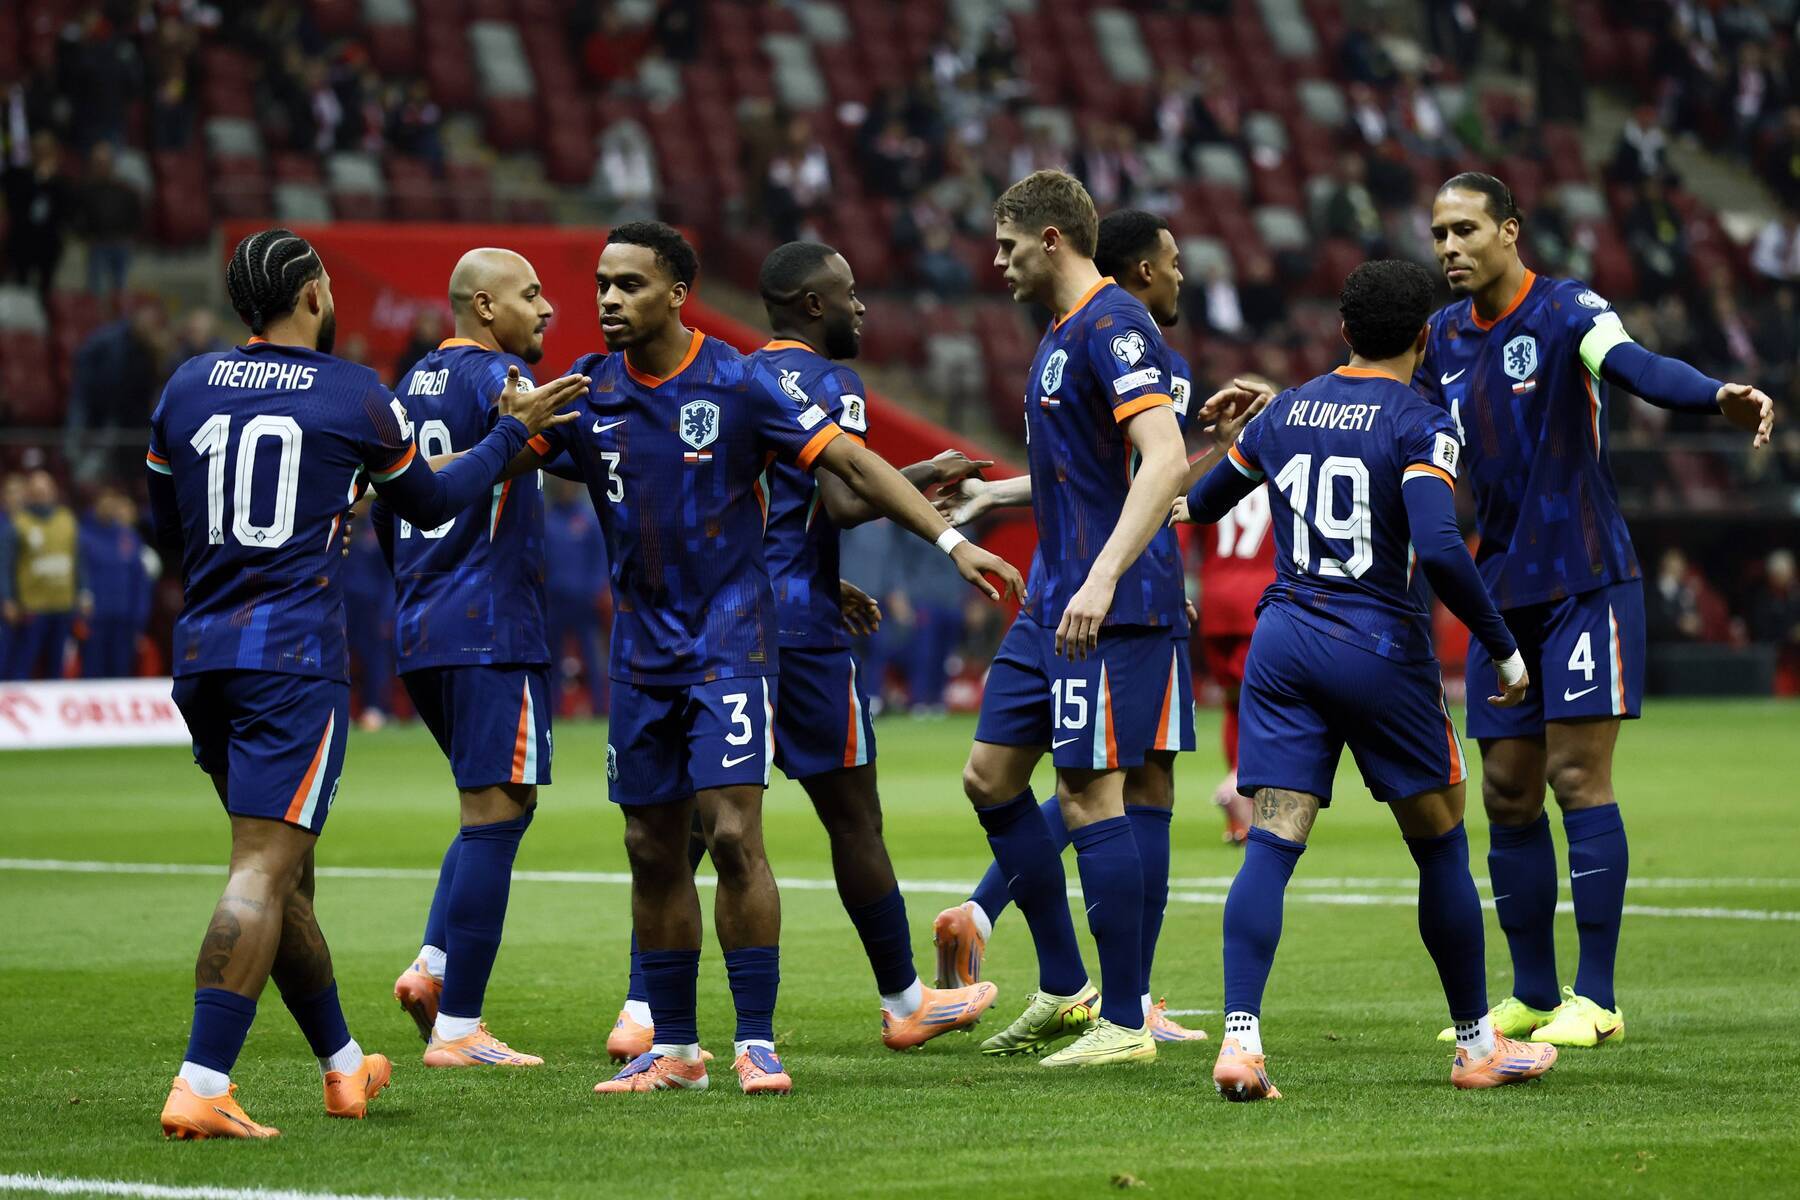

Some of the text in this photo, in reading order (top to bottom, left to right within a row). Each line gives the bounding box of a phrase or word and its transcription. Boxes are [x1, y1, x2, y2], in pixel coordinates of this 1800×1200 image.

[208, 360, 318, 389] MEMPHIS
[1286, 400, 1381, 431] KLUIVERT
[190, 414, 303, 549] 10
[600, 451, 625, 503] 3
[1274, 453, 1373, 579] 19
[1568, 632, 1595, 681] 4
[722, 693, 753, 746] 3
[1051, 679, 1088, 730] 15
